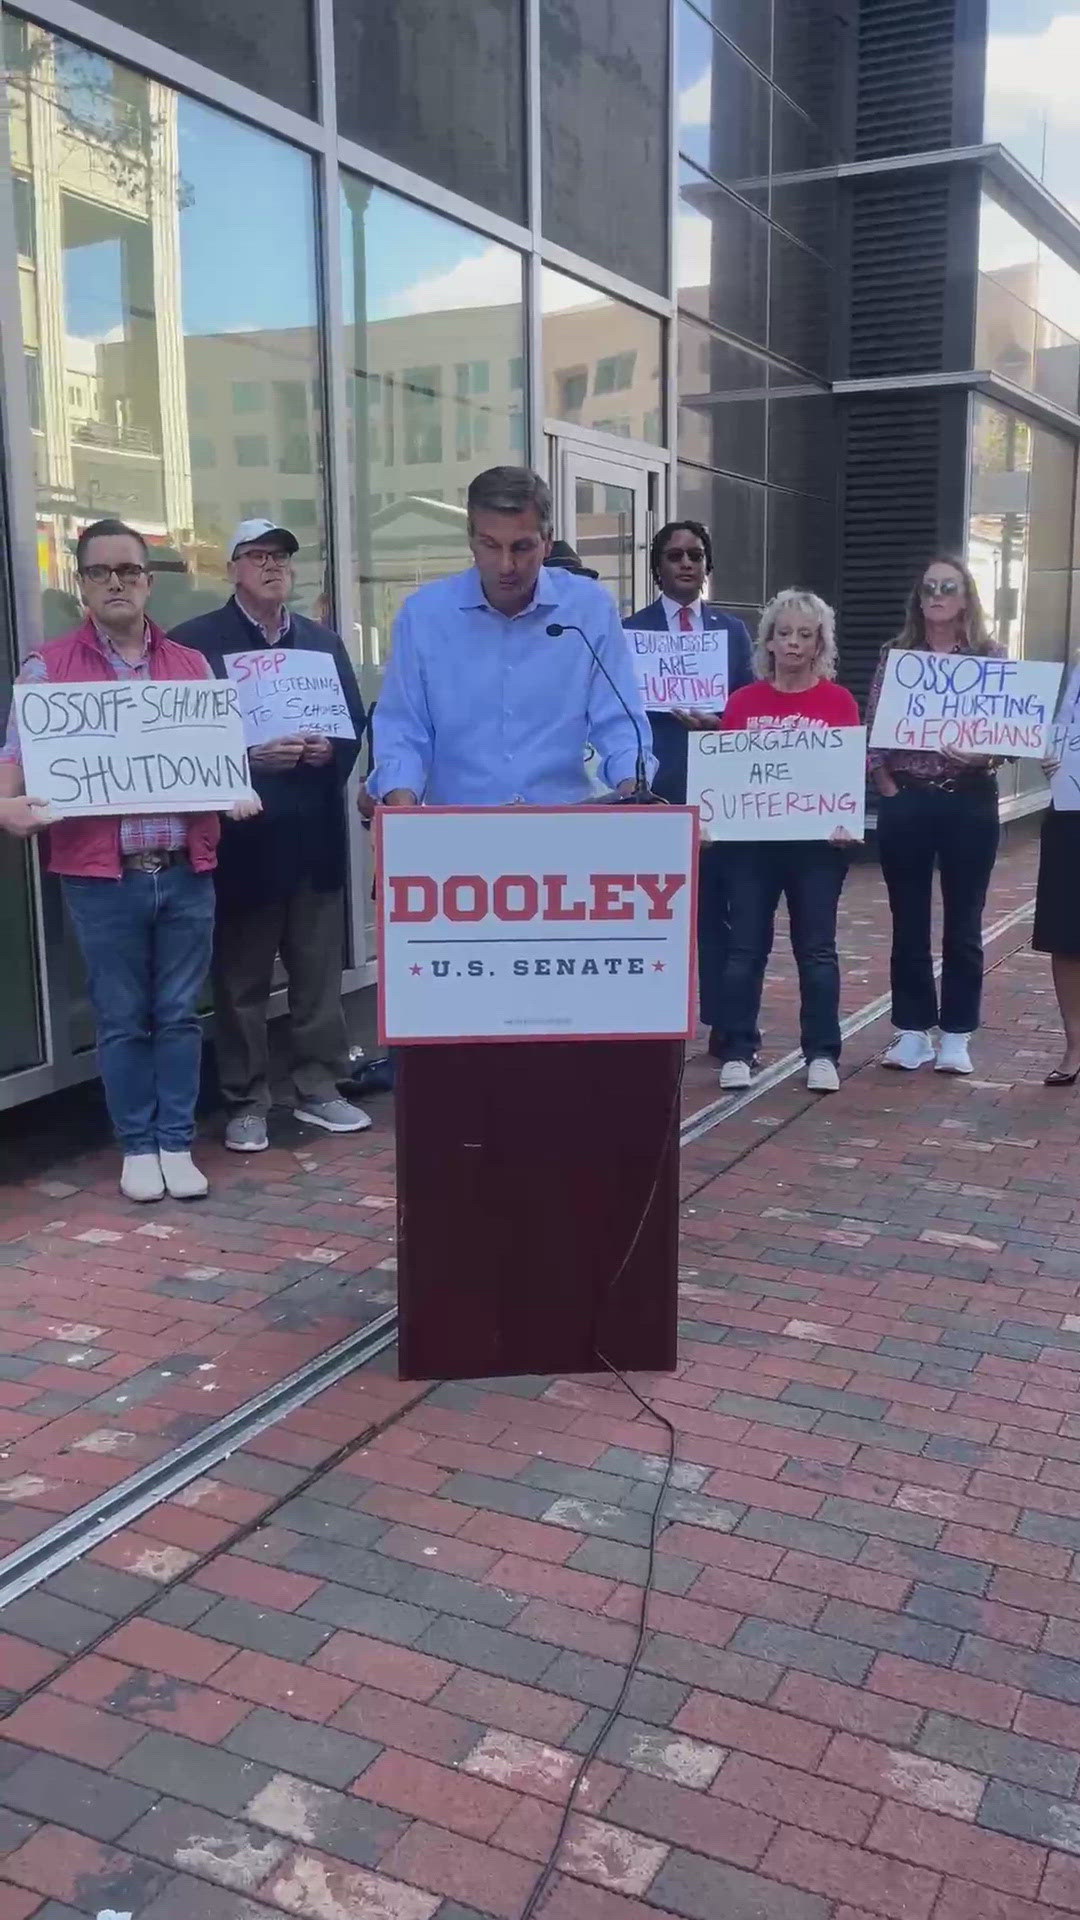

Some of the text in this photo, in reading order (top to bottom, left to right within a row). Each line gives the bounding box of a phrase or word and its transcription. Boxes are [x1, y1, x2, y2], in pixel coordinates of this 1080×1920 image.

[633, 632, 719, 655] BUSINESSES
[232, 652, 286, 683] STOP
[659, 653, 699, 677] ARE
[895, 652, 1018, 695] OSSOFF
[255, 676, 340, 699] LISTENING
[248, 705, 273, 726] TO
[906, 693, 925, 718] IS
[942, 694, 1045, 724] HURTING
[699, 730, 844, 756] GEORGIANS
[895, 718, 1043, 749] GEORGIANS
[50, 754, 248, 804] SHUTDOWN
[750, 762, 793, 784] ARE
[700, 788, 857, 822] SUFFERING
[388, 873, 687, 923] DOOLEY
[431, 957, 645, 978] U.S. SENATE
